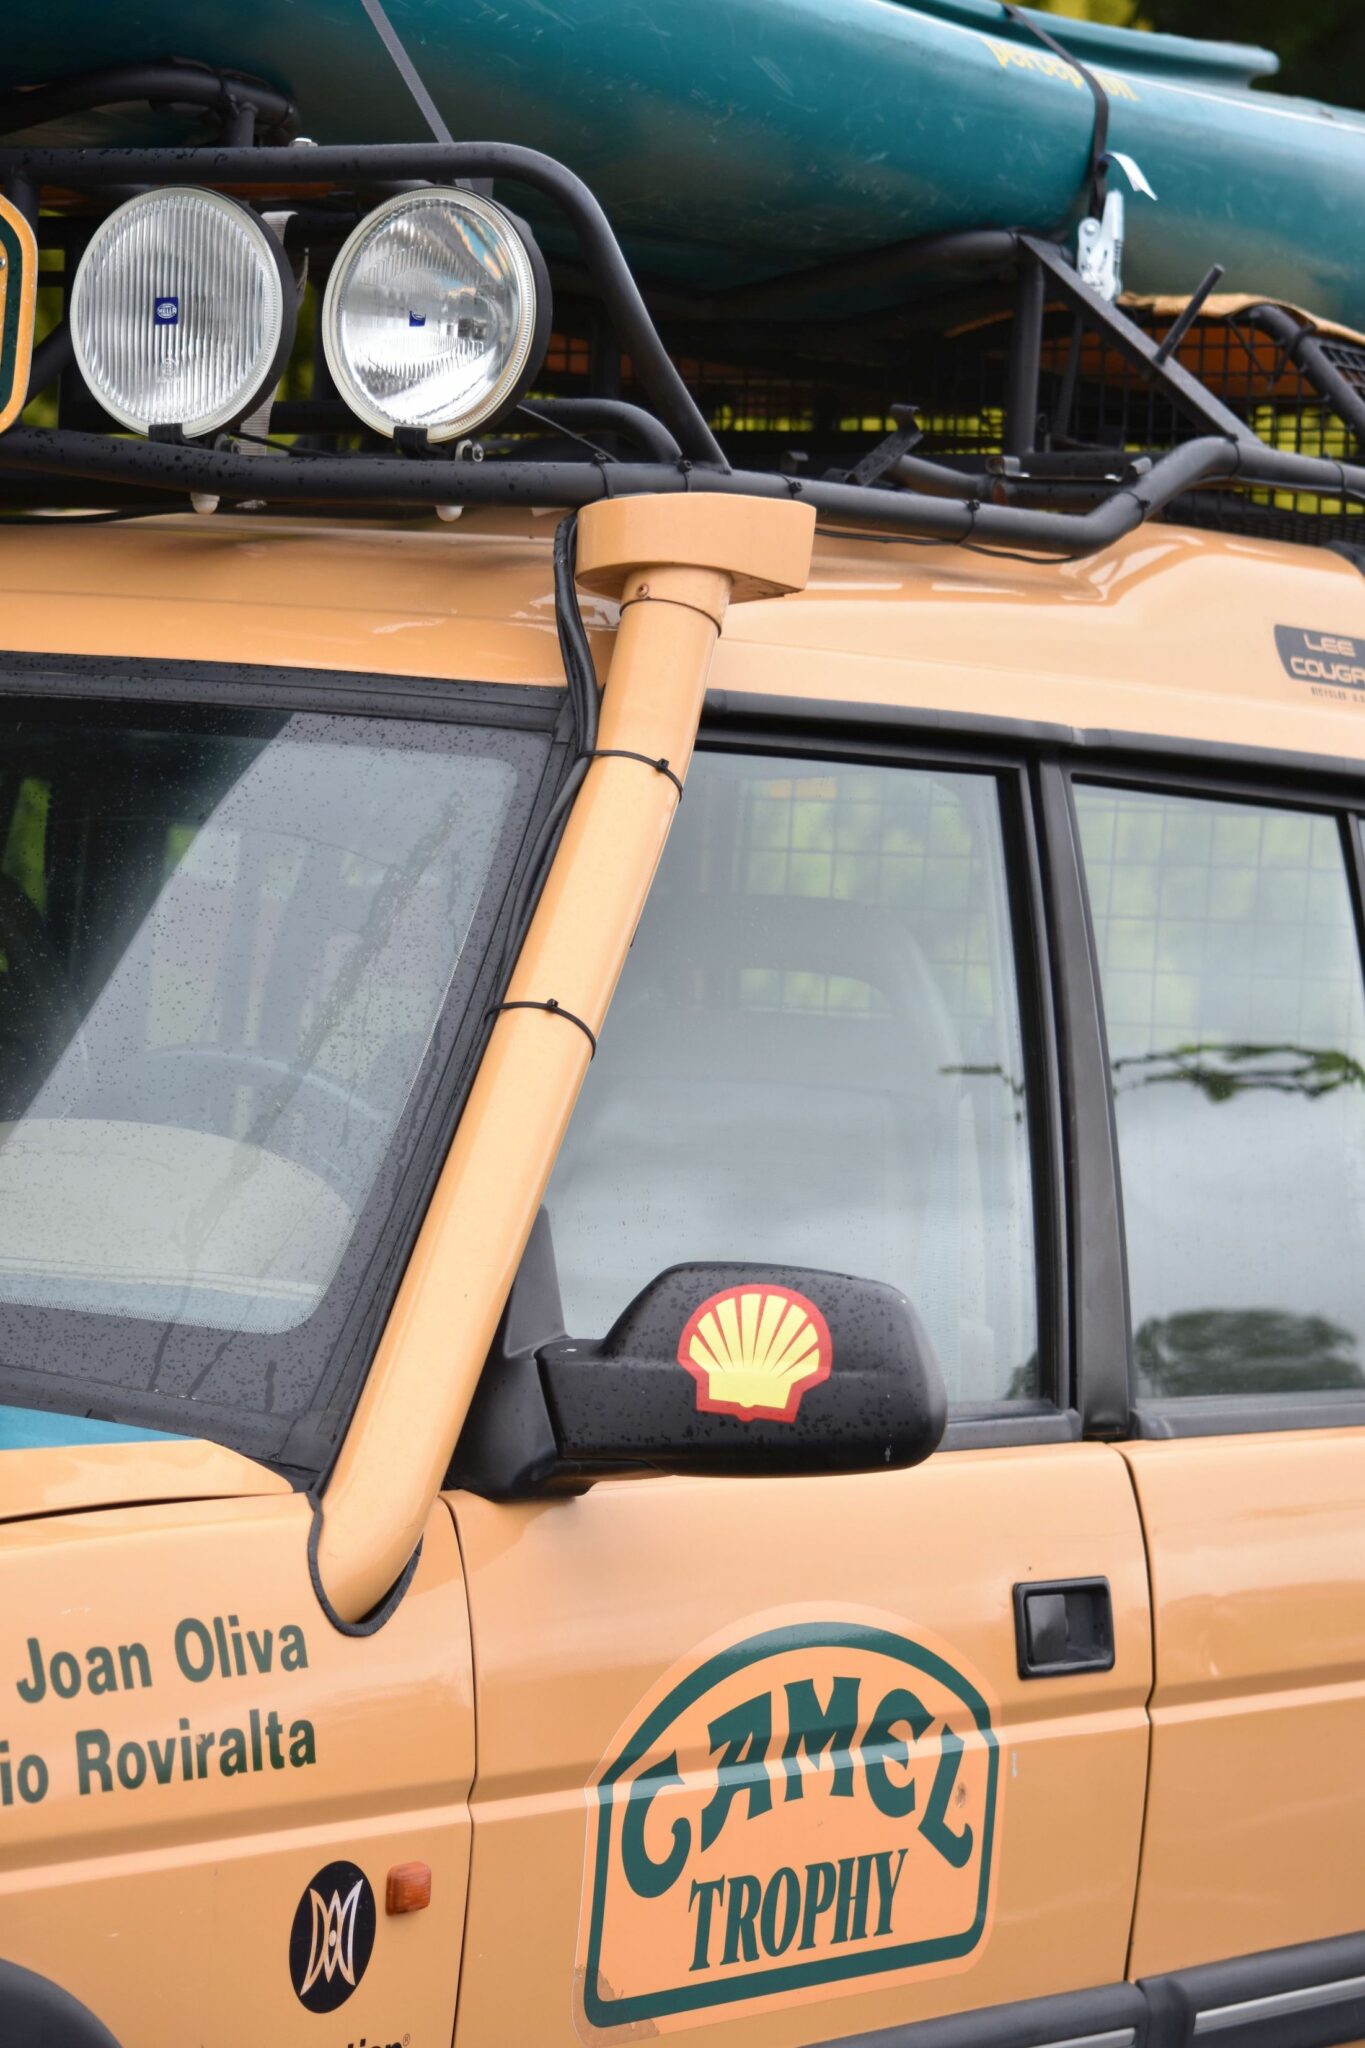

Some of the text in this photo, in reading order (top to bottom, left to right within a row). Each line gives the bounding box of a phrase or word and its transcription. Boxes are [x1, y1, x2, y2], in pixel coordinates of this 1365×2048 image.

[1303, 632, 1356, 658] LEE
[16, 1614, 309, 1704] Joan Oliva
[75, 1709, 316, 1795] Roviralta
[621, 1676, 973, 1898] CAMEL
[689, 1848, 908, 1971] TROPHY
